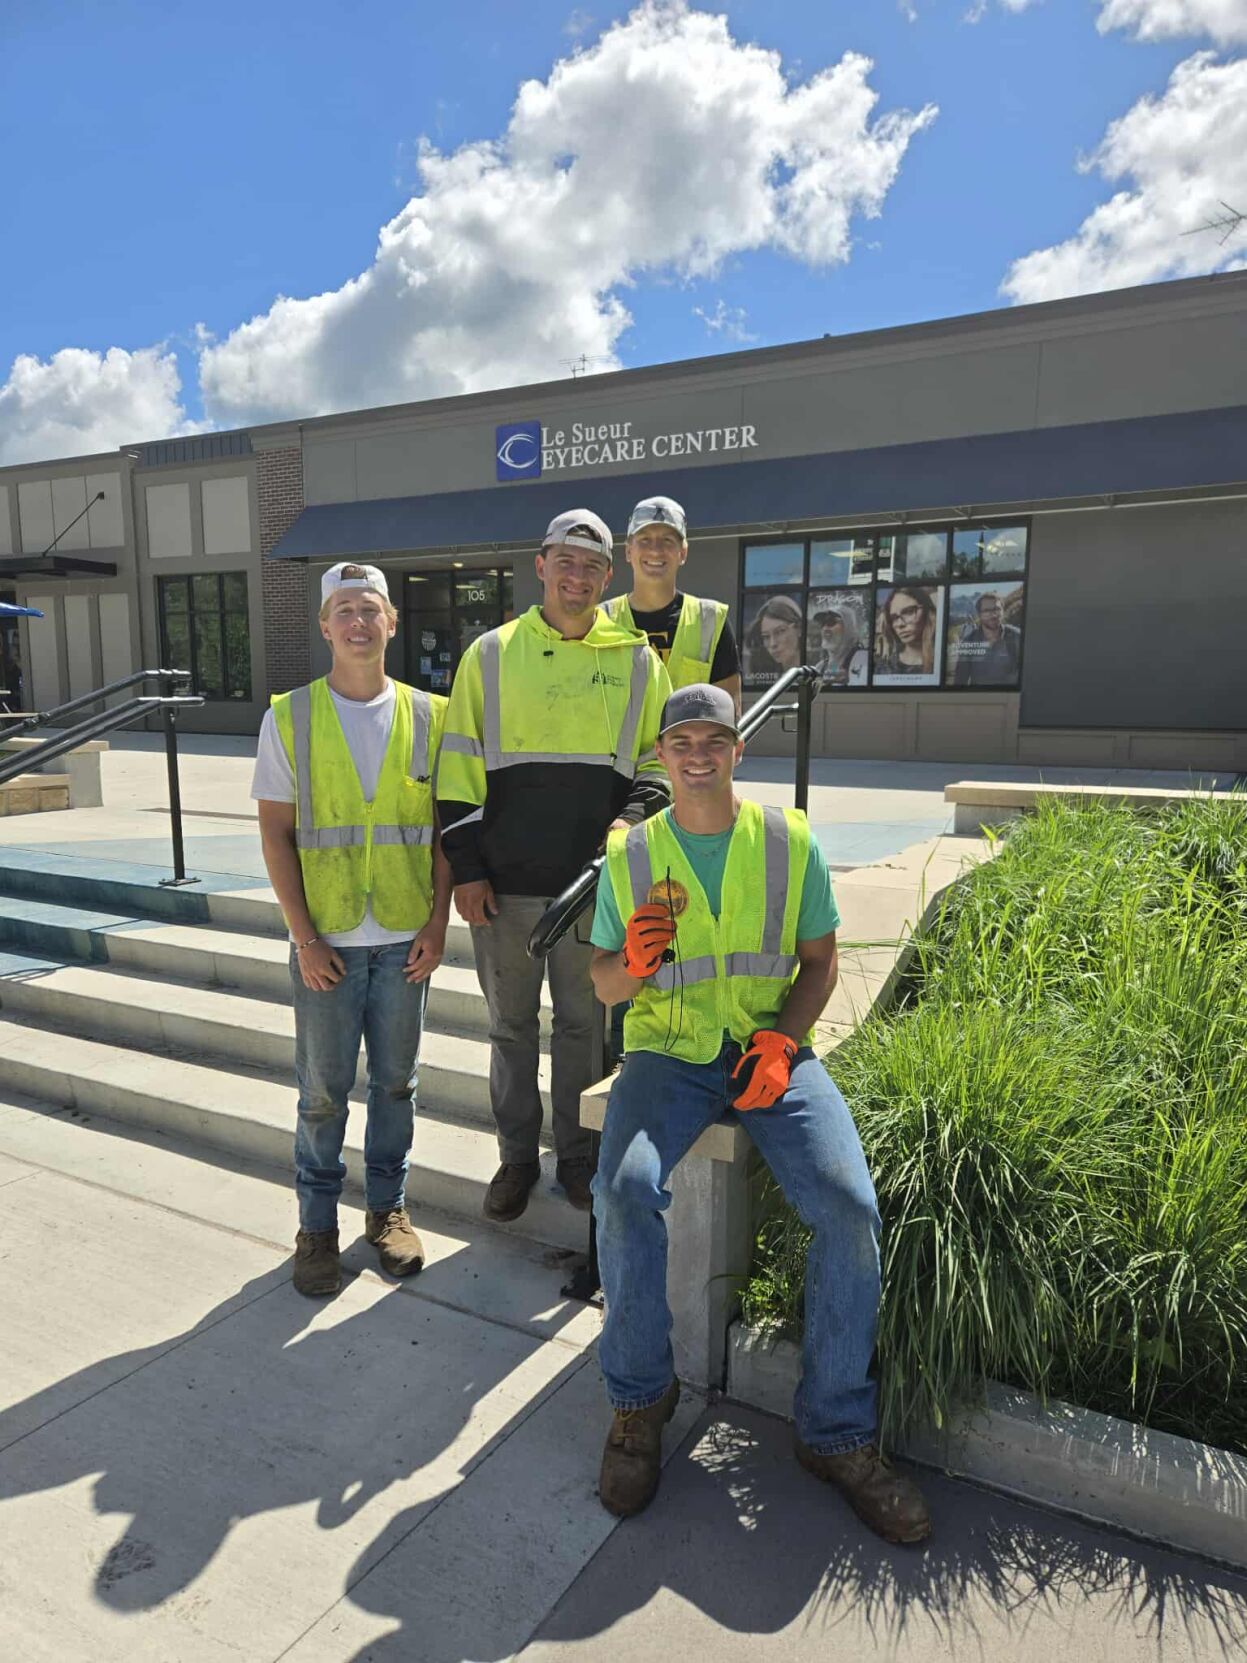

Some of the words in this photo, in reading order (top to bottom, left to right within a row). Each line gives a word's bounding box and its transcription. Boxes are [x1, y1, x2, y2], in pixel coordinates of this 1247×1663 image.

[541, 427, 565, 448] Le
[572, 422, 632, 443] Sueur
[541, 438, 646, 470] EYECARE
[652, 425, 758, 457] CENTER
[467, 590, 485, 601] 105
